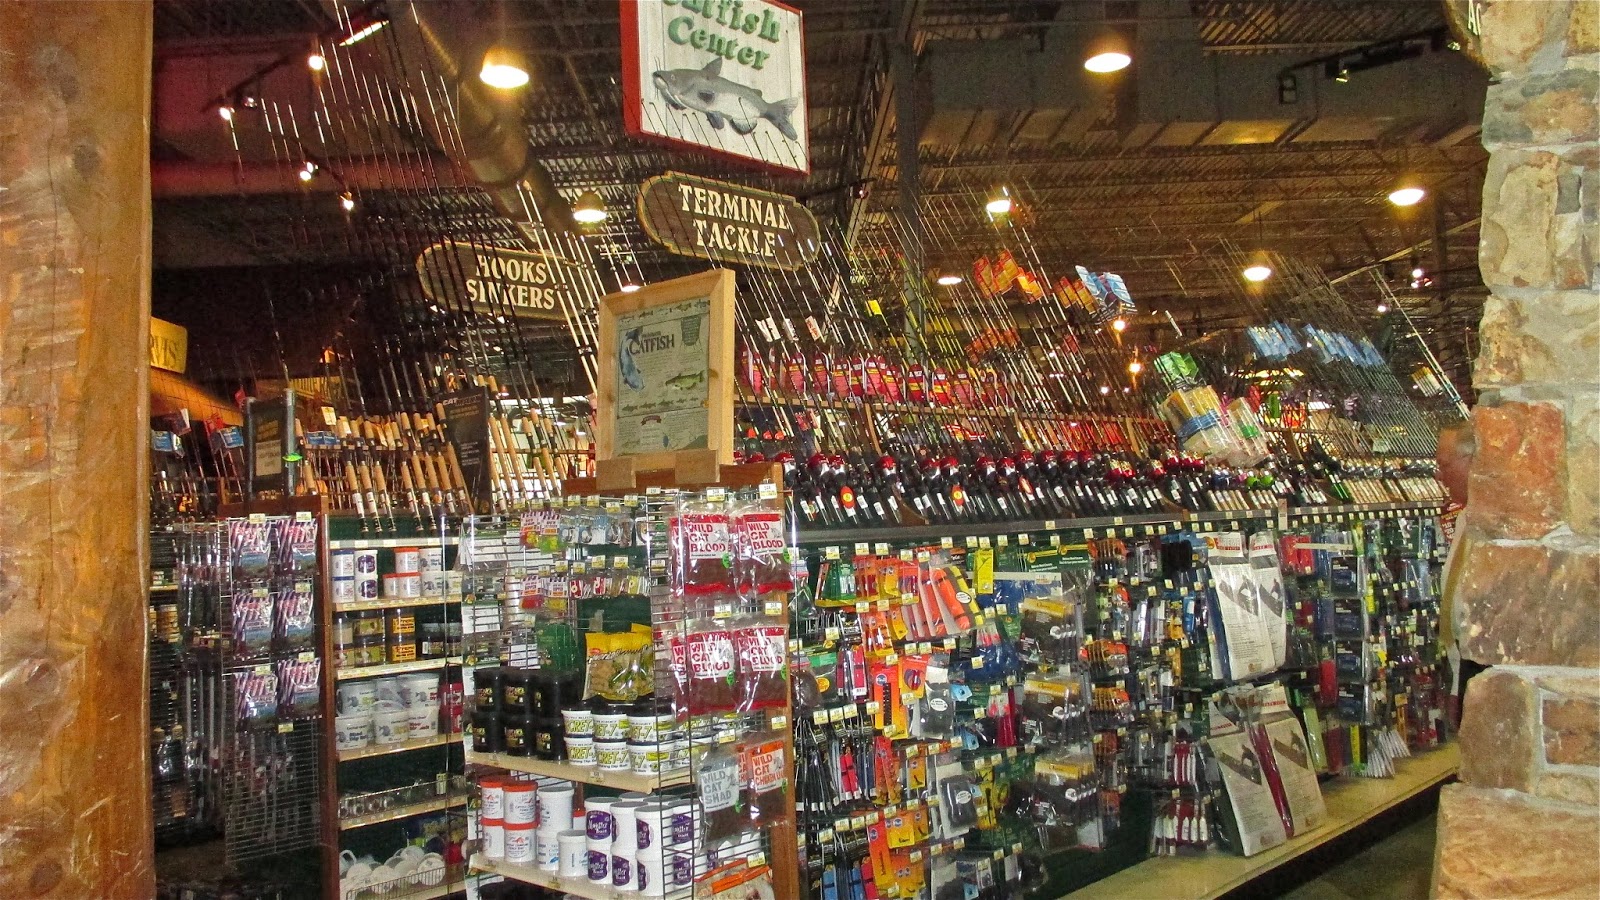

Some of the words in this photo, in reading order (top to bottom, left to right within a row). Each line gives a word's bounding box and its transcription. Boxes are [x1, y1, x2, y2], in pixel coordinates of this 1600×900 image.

[668, 16, 770, 70] Center
[678, 183, 790, 230] TERMINAL
[693, 219, 776, 257] TACKLE
[476, 254, 547, 285] HOOKS
[466, 279, 555, 310] SINKERS
[628, 334, 675, 355] CATFISH
[689, 523, 713, 533] WILD
[748, 522, 770, 532] WILD
[689, 534, 709, 542] CAT
[750, 531, 768, 540] CAT
[690, 543, 726, 552] BLOOD
[753, 540, 783, 550] BLOOD
[753, 754, 772, 766] WILD
[754, 764, 770, 776] CAT
[702, 771, 726, 785] WILD
[704, 784, 723, 794] CAT
[705, 791, 732, 804] SHAD
